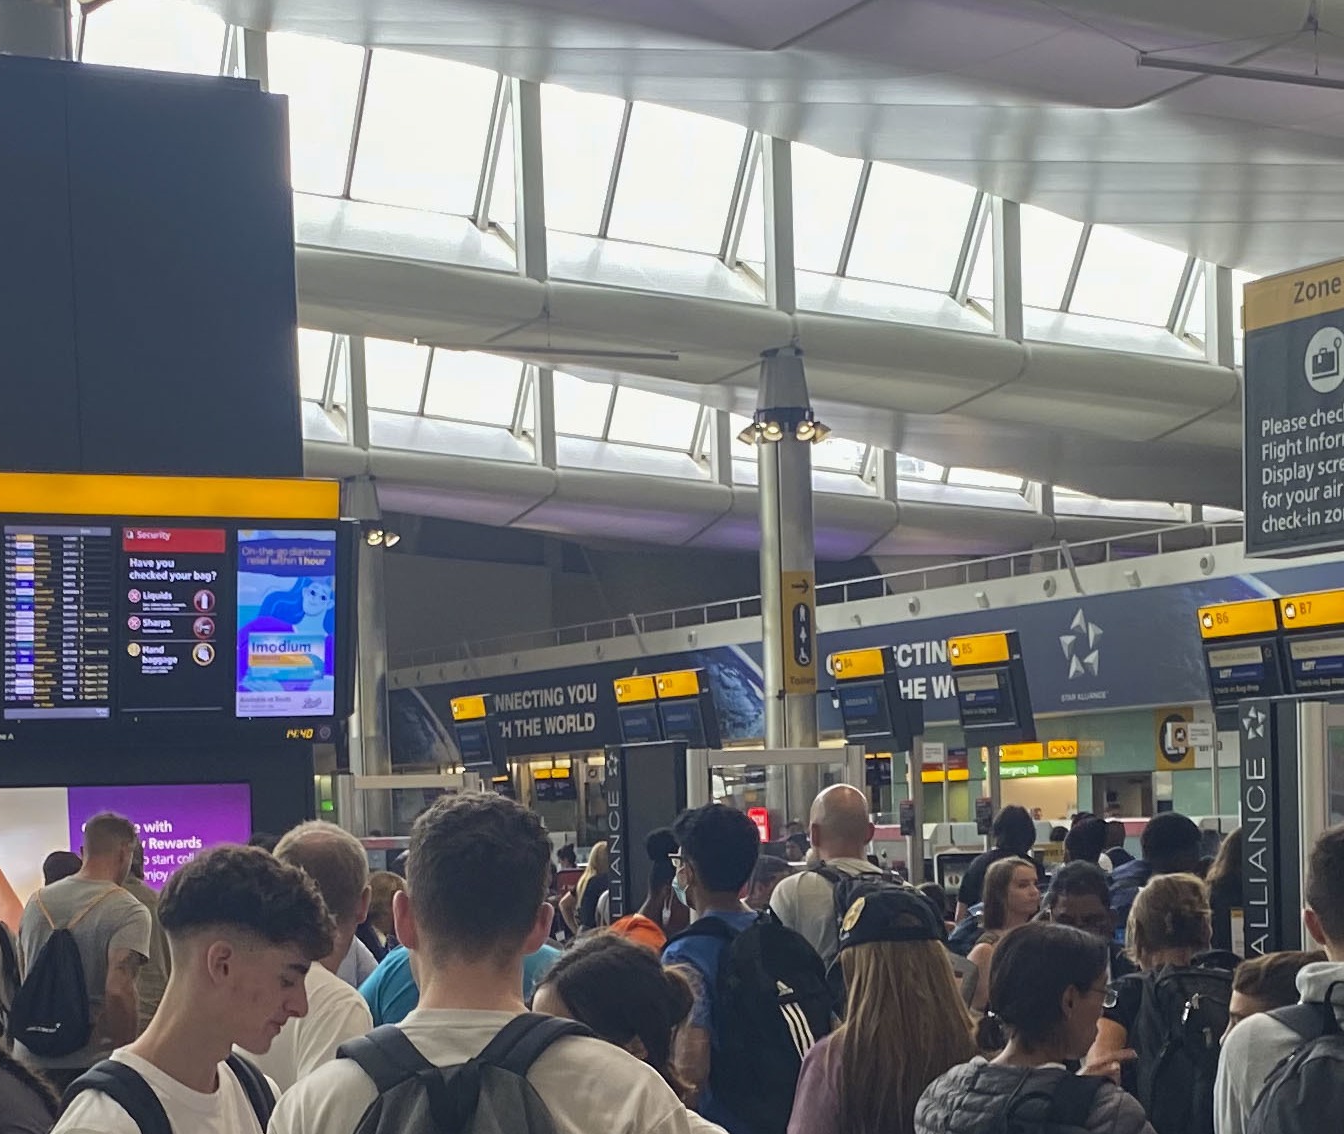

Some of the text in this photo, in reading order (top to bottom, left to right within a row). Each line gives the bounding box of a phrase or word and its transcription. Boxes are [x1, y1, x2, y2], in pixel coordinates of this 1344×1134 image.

[1293, 274, 1342, 305] Zone
[1261, 418, 1307, 438] Please
[1261, 440, 1302, 463] Flight
[1261, 461, 1314, 486] Display
[1262, 490, 1283, 510] for
[1286, 484, 1320, 509] your
[1261, 510, 1321, 533] check-in
[137, 531, 172, 541] Security
[129, 557, 175, 570] Have you
[304, 556, 326, 566] hour
[129, 570, 218, 583] checked your bag?
[142, 591, 173, 602] Liquids
[1299, 601, 1313, 615] B7
[142, 618, 171, 629] Sharps
[1216, 611, 1230, 625] B6
[142, 645, 165, 655] Hand
[251, 639, 312, 654] Imodium
[893, 638, 948, 669] CTIN
[141, 656, 178, 665] baggage
[567, 682, 597, 705] YOU
[514, 717, 542, 738] THE
[544, 712, 596, 736] WORLD
[7, 733, 14, 741] A
[286, 728, 315, 739] 14:40
[143, 820, 173, 833] with
[148, 836, 202, 850] Rewards
[151, 854, 175, 865] start
[1245, 757, 1270, 955] ALLIANCE
